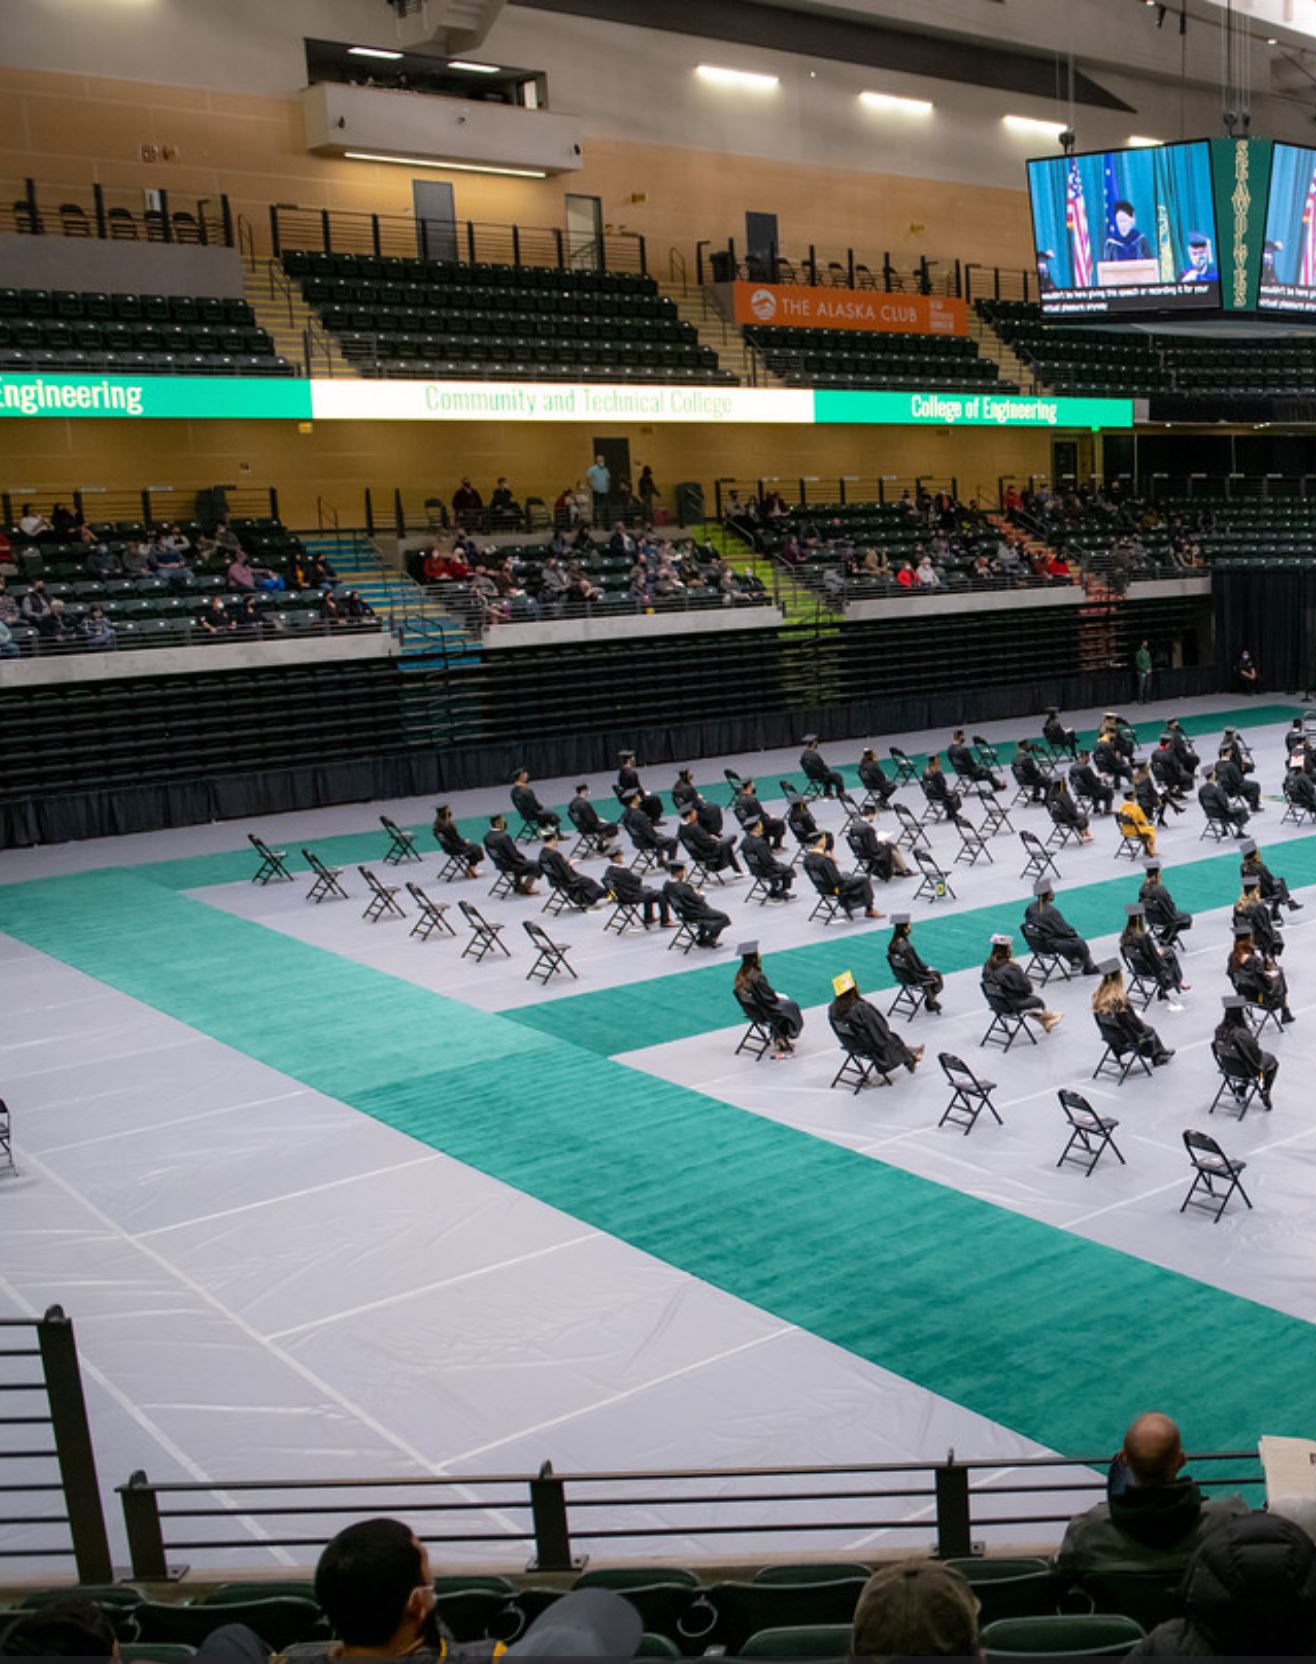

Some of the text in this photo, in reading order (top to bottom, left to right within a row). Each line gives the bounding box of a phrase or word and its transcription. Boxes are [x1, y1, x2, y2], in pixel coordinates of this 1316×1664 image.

[781, 298, 810, 316] THE
[816, 301, 876, 320] ALASKA
[880, 305, 918, 323] CLUB
[0, 378, 143, 415] ngineering
[425, 385, 733, 418] Community and Technical College
[911, 395, 1058, 424] College of Engineering
